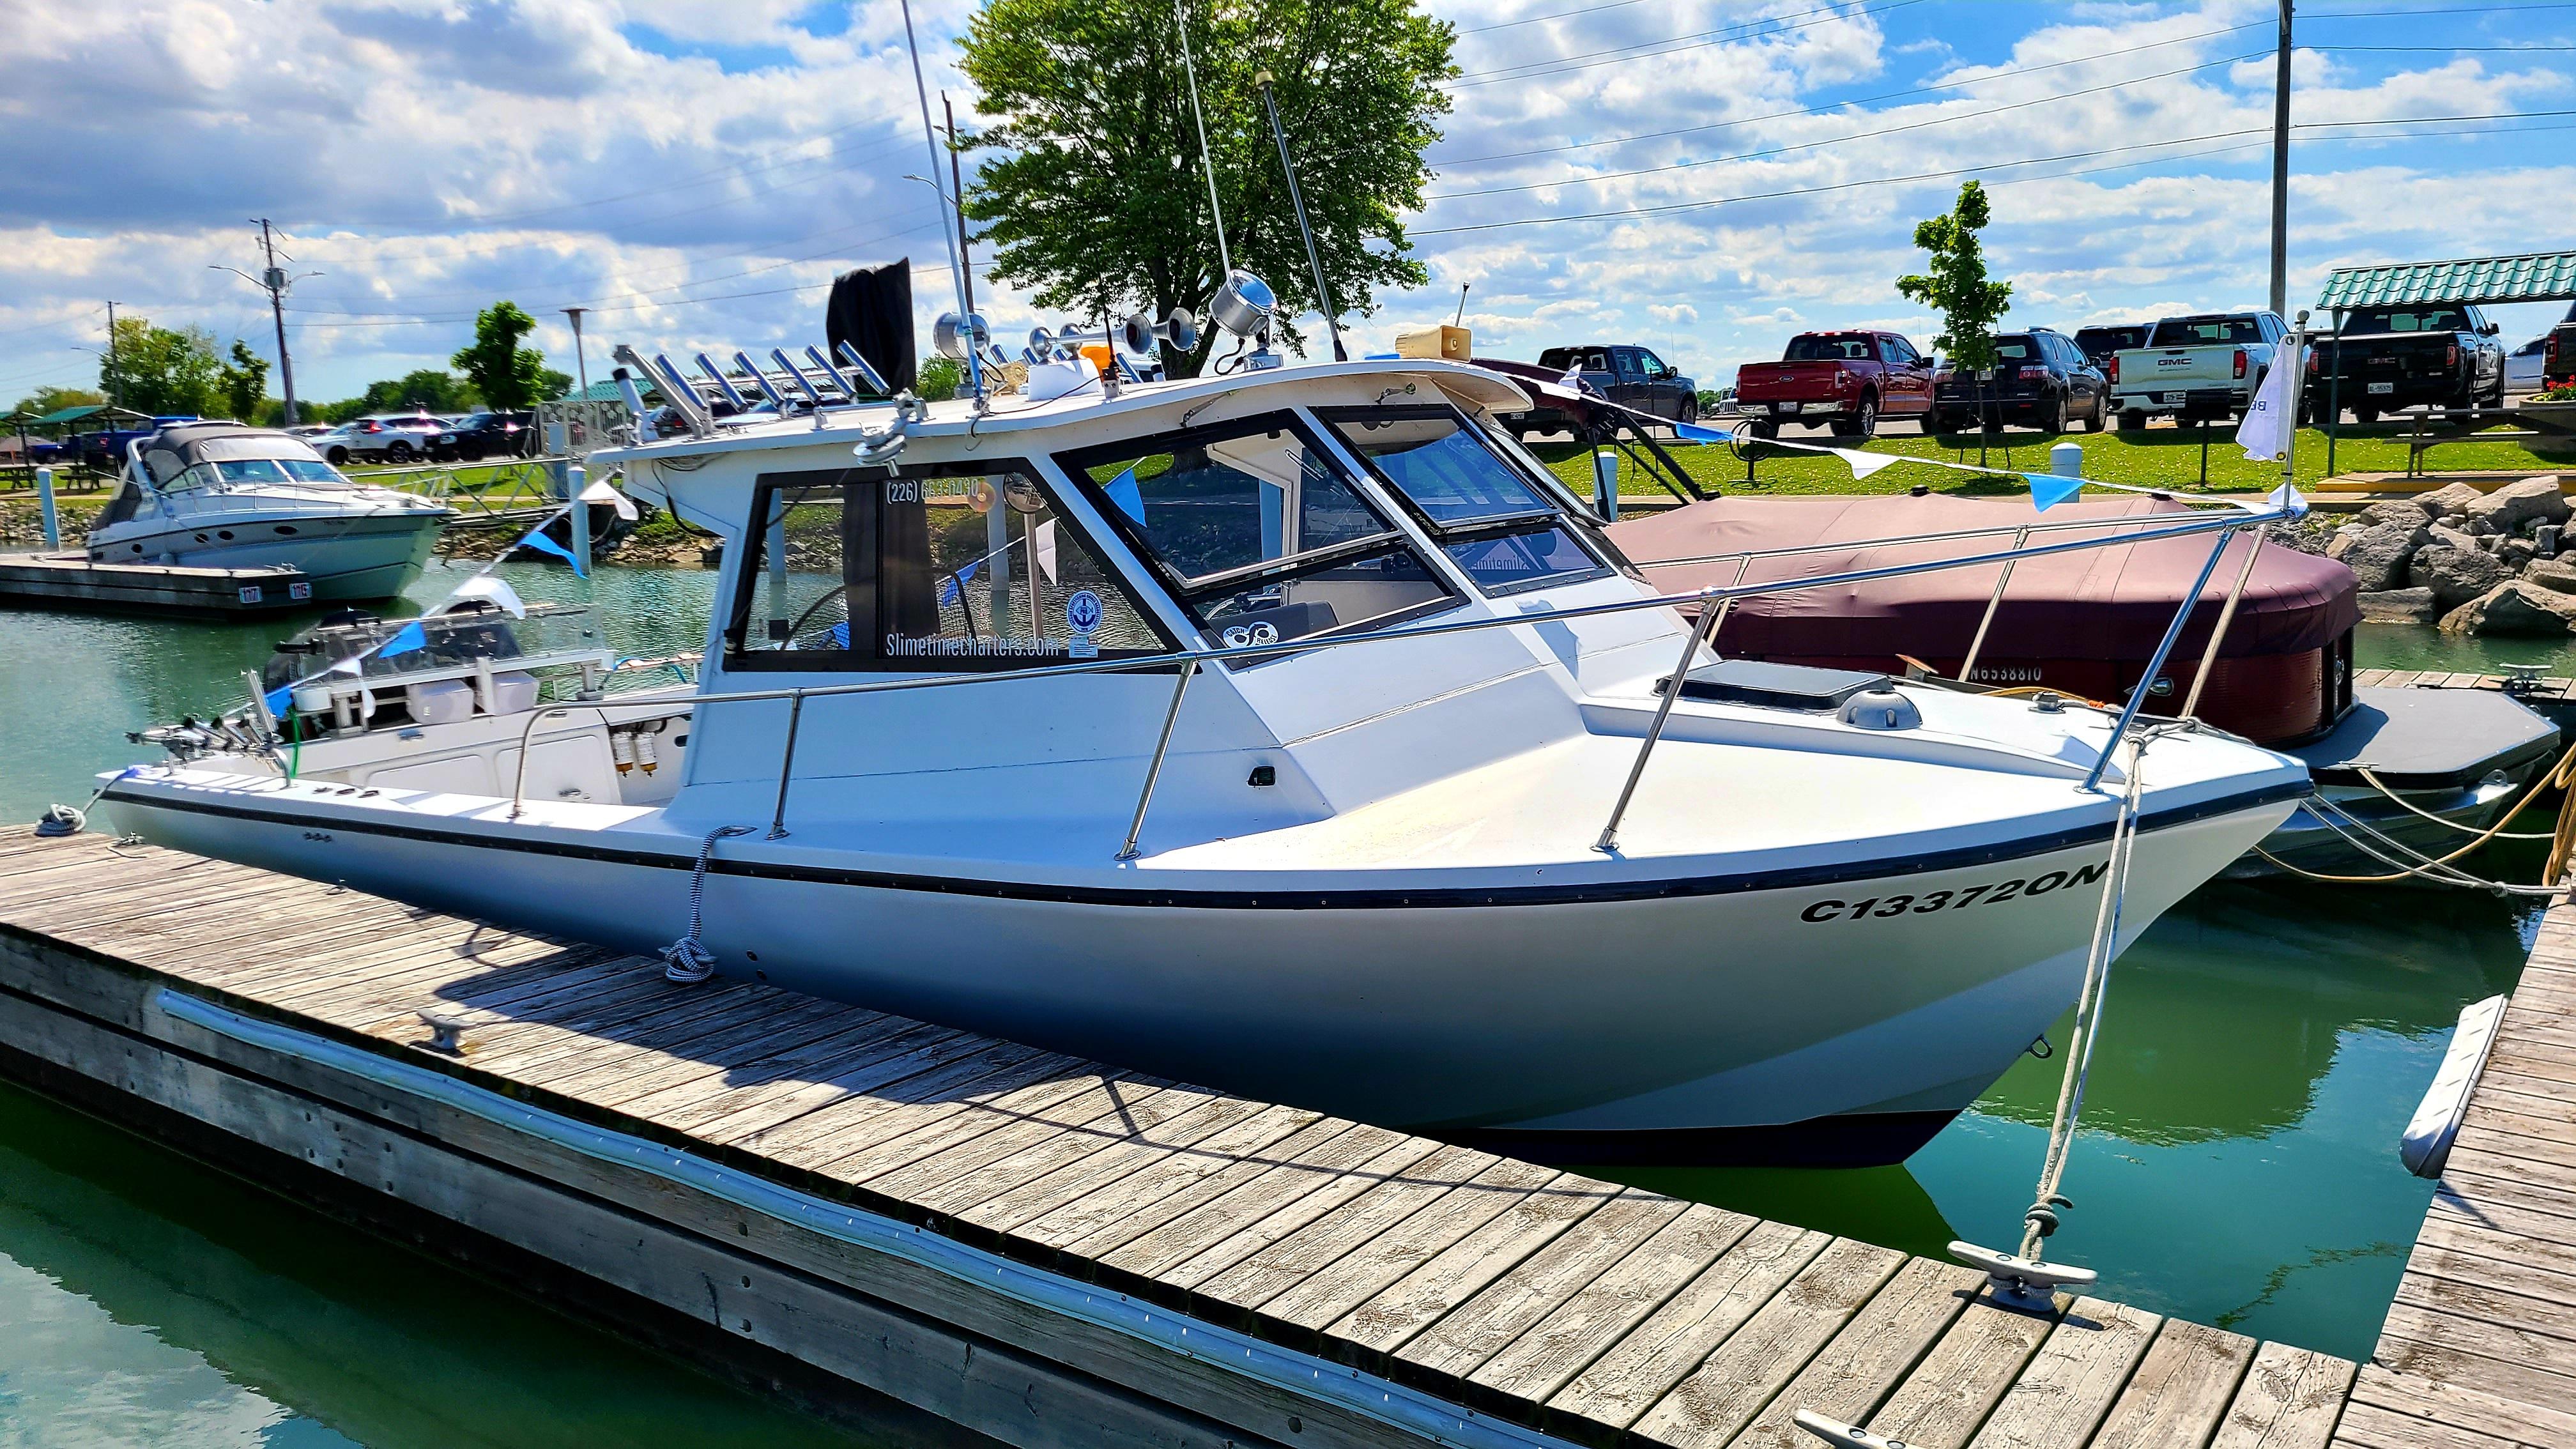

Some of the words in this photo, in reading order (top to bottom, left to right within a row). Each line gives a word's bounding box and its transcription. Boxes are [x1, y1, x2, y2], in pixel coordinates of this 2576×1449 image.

[2158, 358, 2193, 367] GMC
[886, 480, 917, 505] (226)
[1226, 628, 1245, 637] CATCH
[1257, 634, 1277, 645] RELEASE
[886, 632, 1059, 656] Slimetimecharters.com
[1800, 860, 2110, 923] C13372ON
